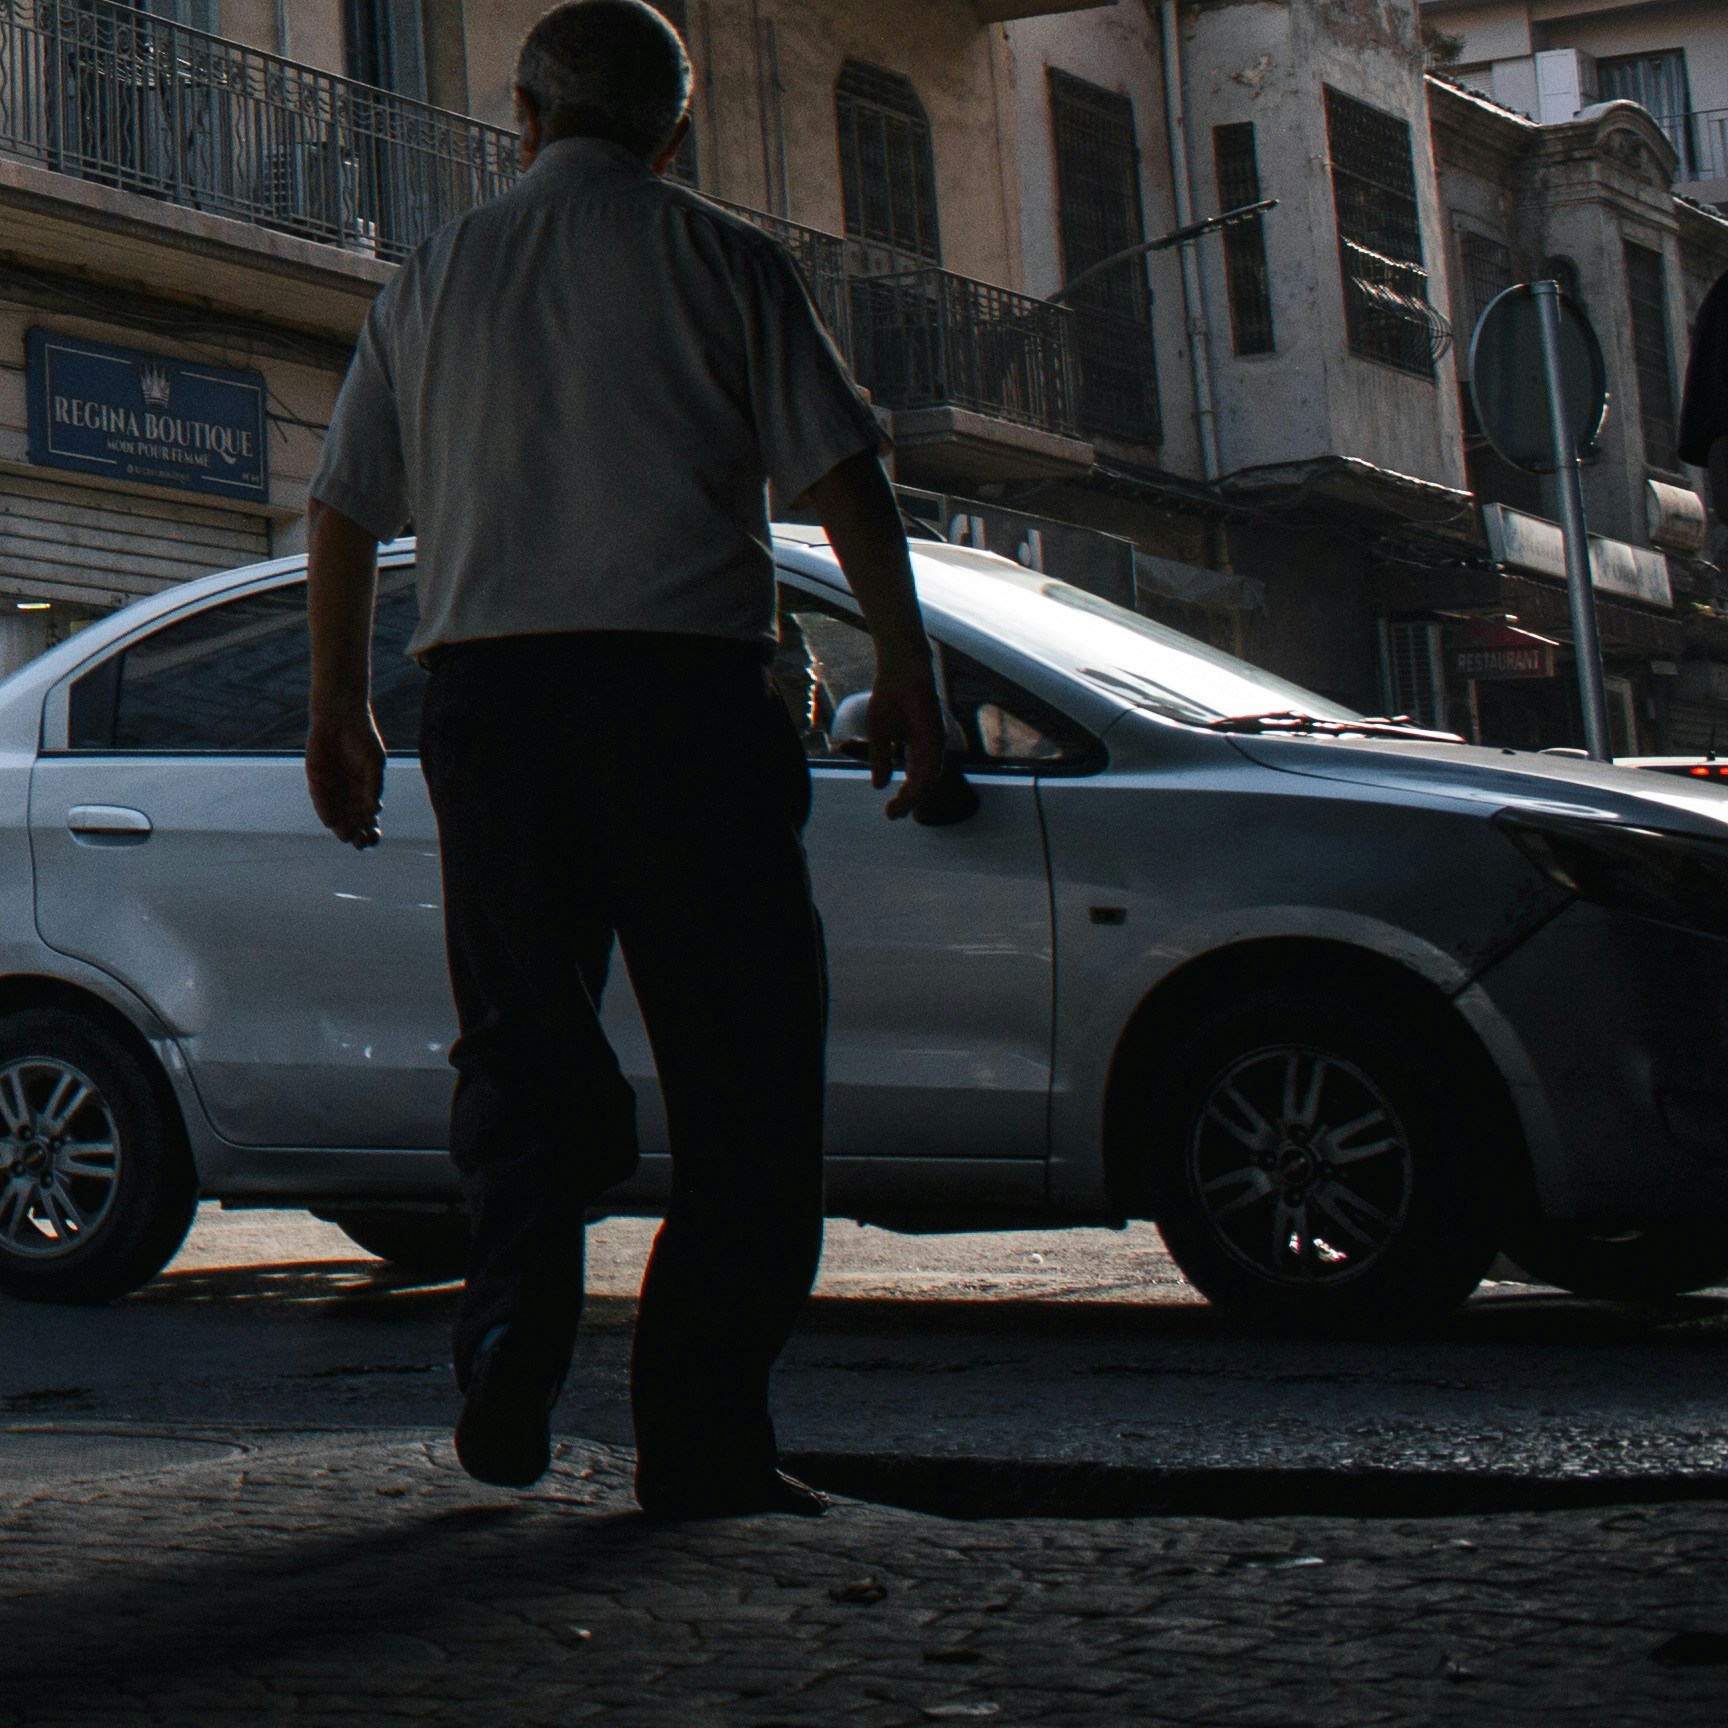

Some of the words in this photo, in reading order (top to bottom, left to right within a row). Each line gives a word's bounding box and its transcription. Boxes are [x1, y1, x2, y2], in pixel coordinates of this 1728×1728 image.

[54, 396, 140, 440] REGINA
[145, 411, 255, 466] BOUTIQUE
[106, 437, 136, 456] MODE
[137, 440, 174, 461] POUR
[174, 446, 211, 470] FEMME
[1457, 649, 1540, 673] RESTAURANT
